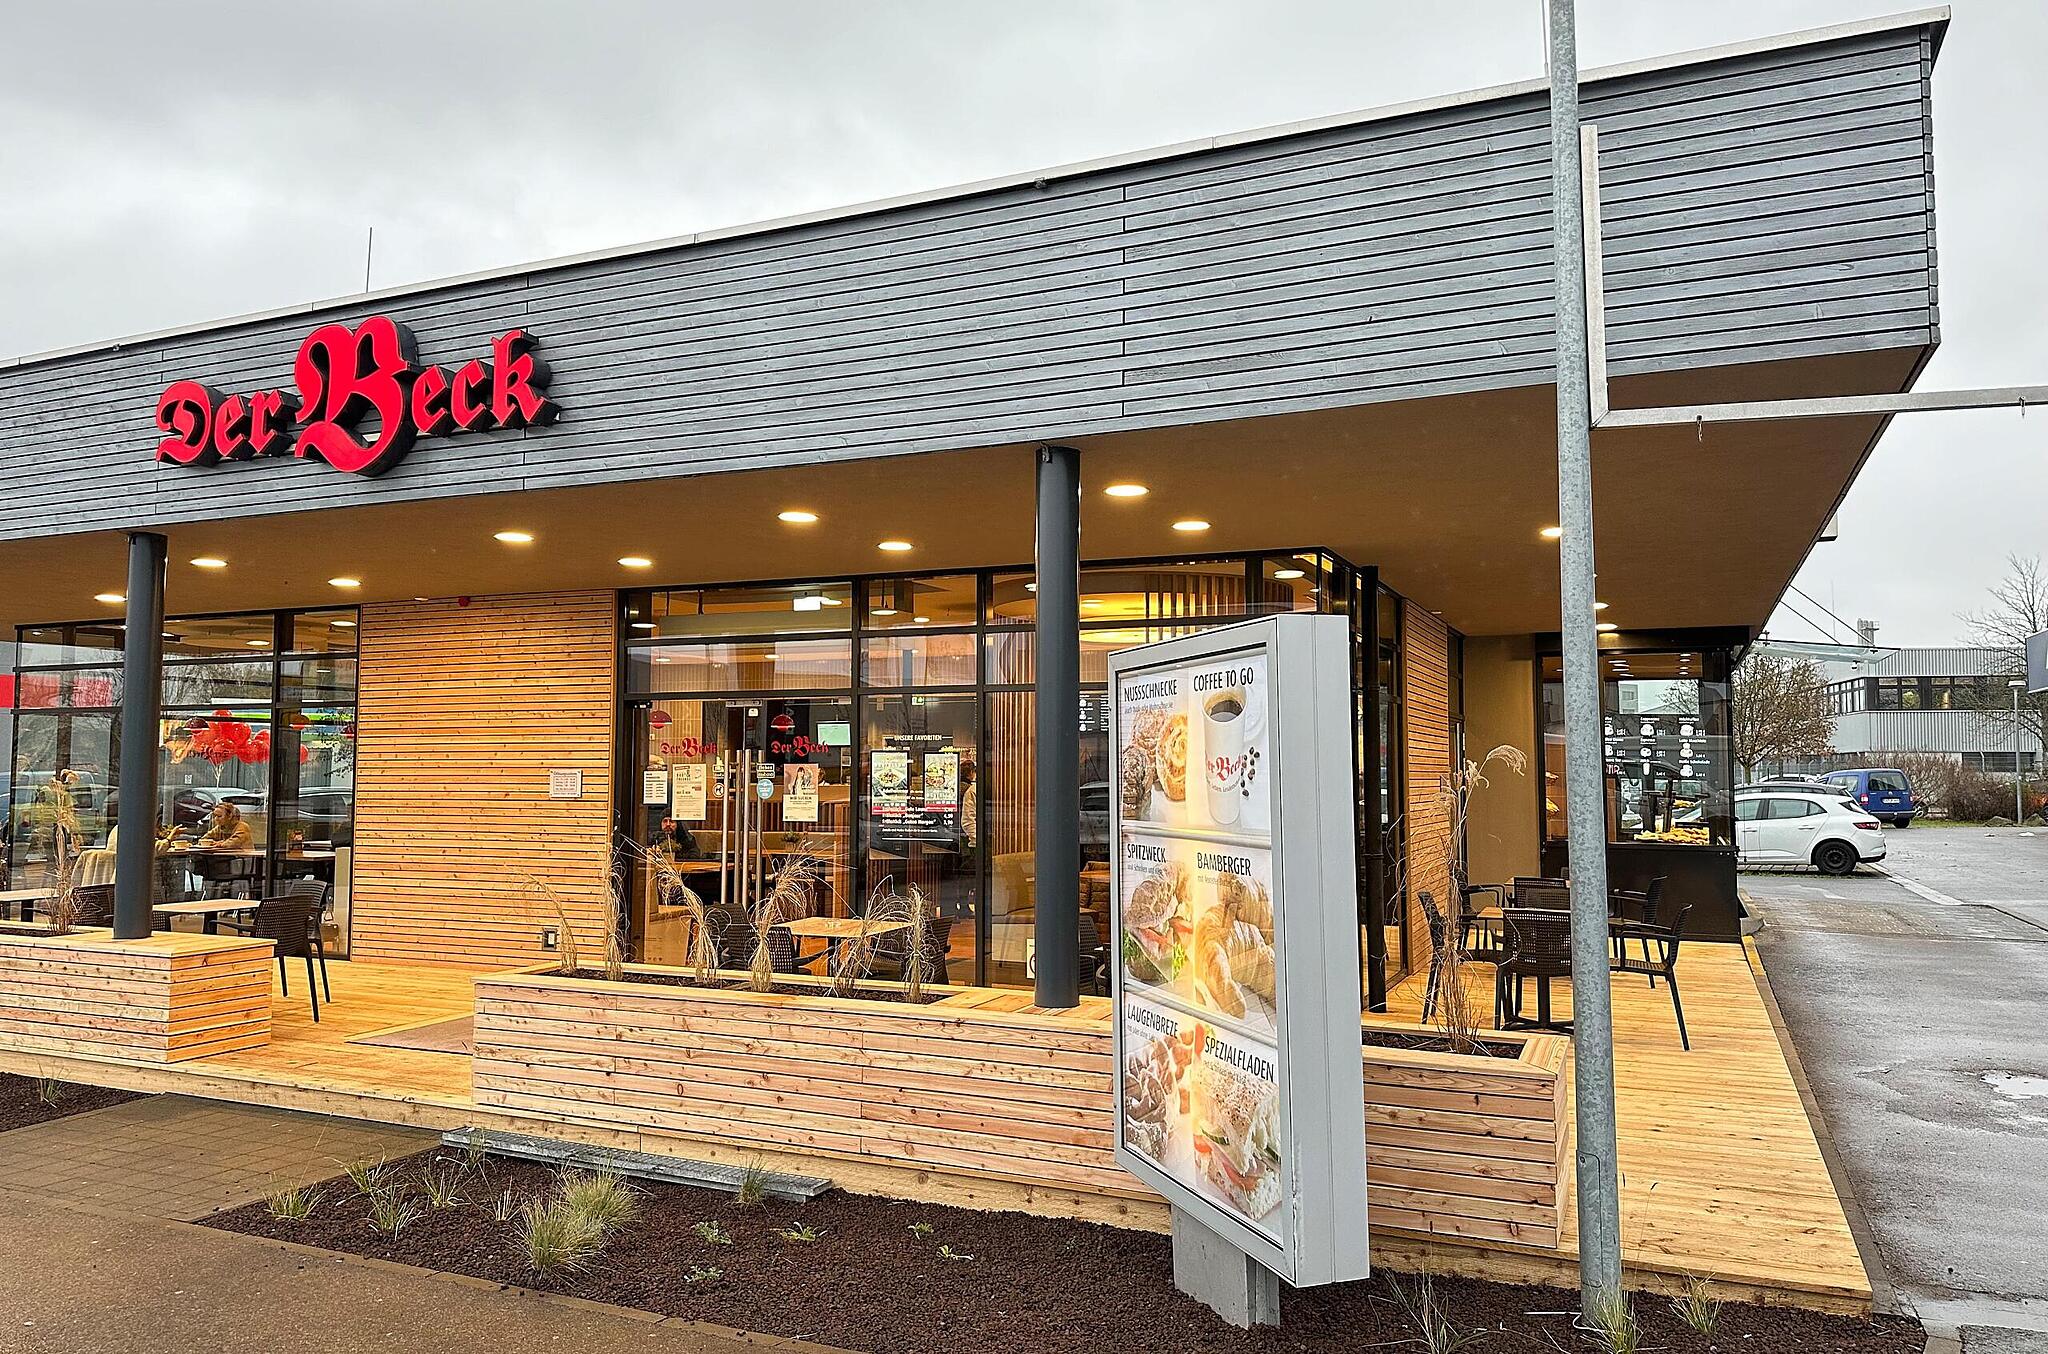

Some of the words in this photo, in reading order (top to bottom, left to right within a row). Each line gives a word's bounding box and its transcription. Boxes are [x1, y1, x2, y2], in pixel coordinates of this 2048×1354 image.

[155, 380, 292, 465] Der
[294, 315, 552, 474] Beck
[1123, 679, 1178, 703] NUSSSCHNECKE
[1193, 671, 1223, 692] COFFEE
[1226, 669, 1237, 688] TO
[1239, 666, 1254, 686] GO
[660, 742, 681, 755] Der
[771, 740, 792, 754] Der
[1127, 843, 1167, 864] SPITZWECK
[1196, 852, 1252, 877] BAMBERGER
[1127, 1003, 1179, 1040] LAUGENBREZE
[1204, 1035, 1275, 1084] SPEZIALFLADEN
